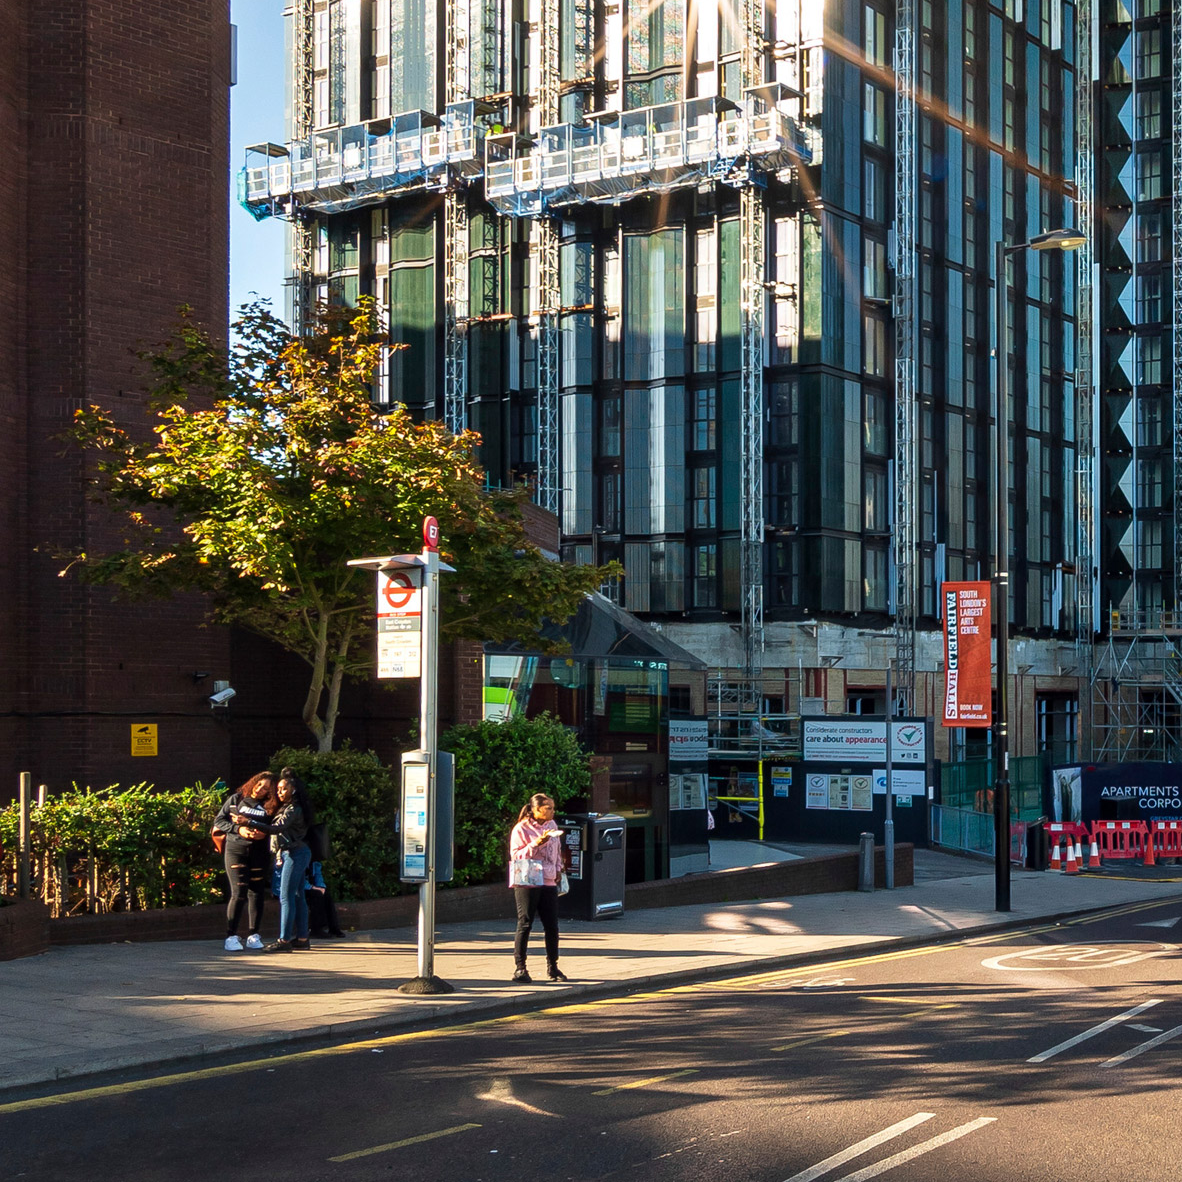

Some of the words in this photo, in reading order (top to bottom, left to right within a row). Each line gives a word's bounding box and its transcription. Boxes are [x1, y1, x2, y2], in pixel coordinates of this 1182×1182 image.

[959, 590, 978, 599] SOUTH
[960, 599, 987, 608] LONDON'S
[960, 608, 983, 617] LARGEST
[960, 617, 974, 626] ARTS
[946, 592, 957, 670] FAIRFIELD
[961, 626, 980, 634] CENTRE
[946, 671, 957, 718] HALLS
[806, 726, 838, 734] Considerate
[822, 735, 844, 743] about
[845, 737, 887, 745] appearance
[1101, 786, 1179, 796] APARTMENTS
